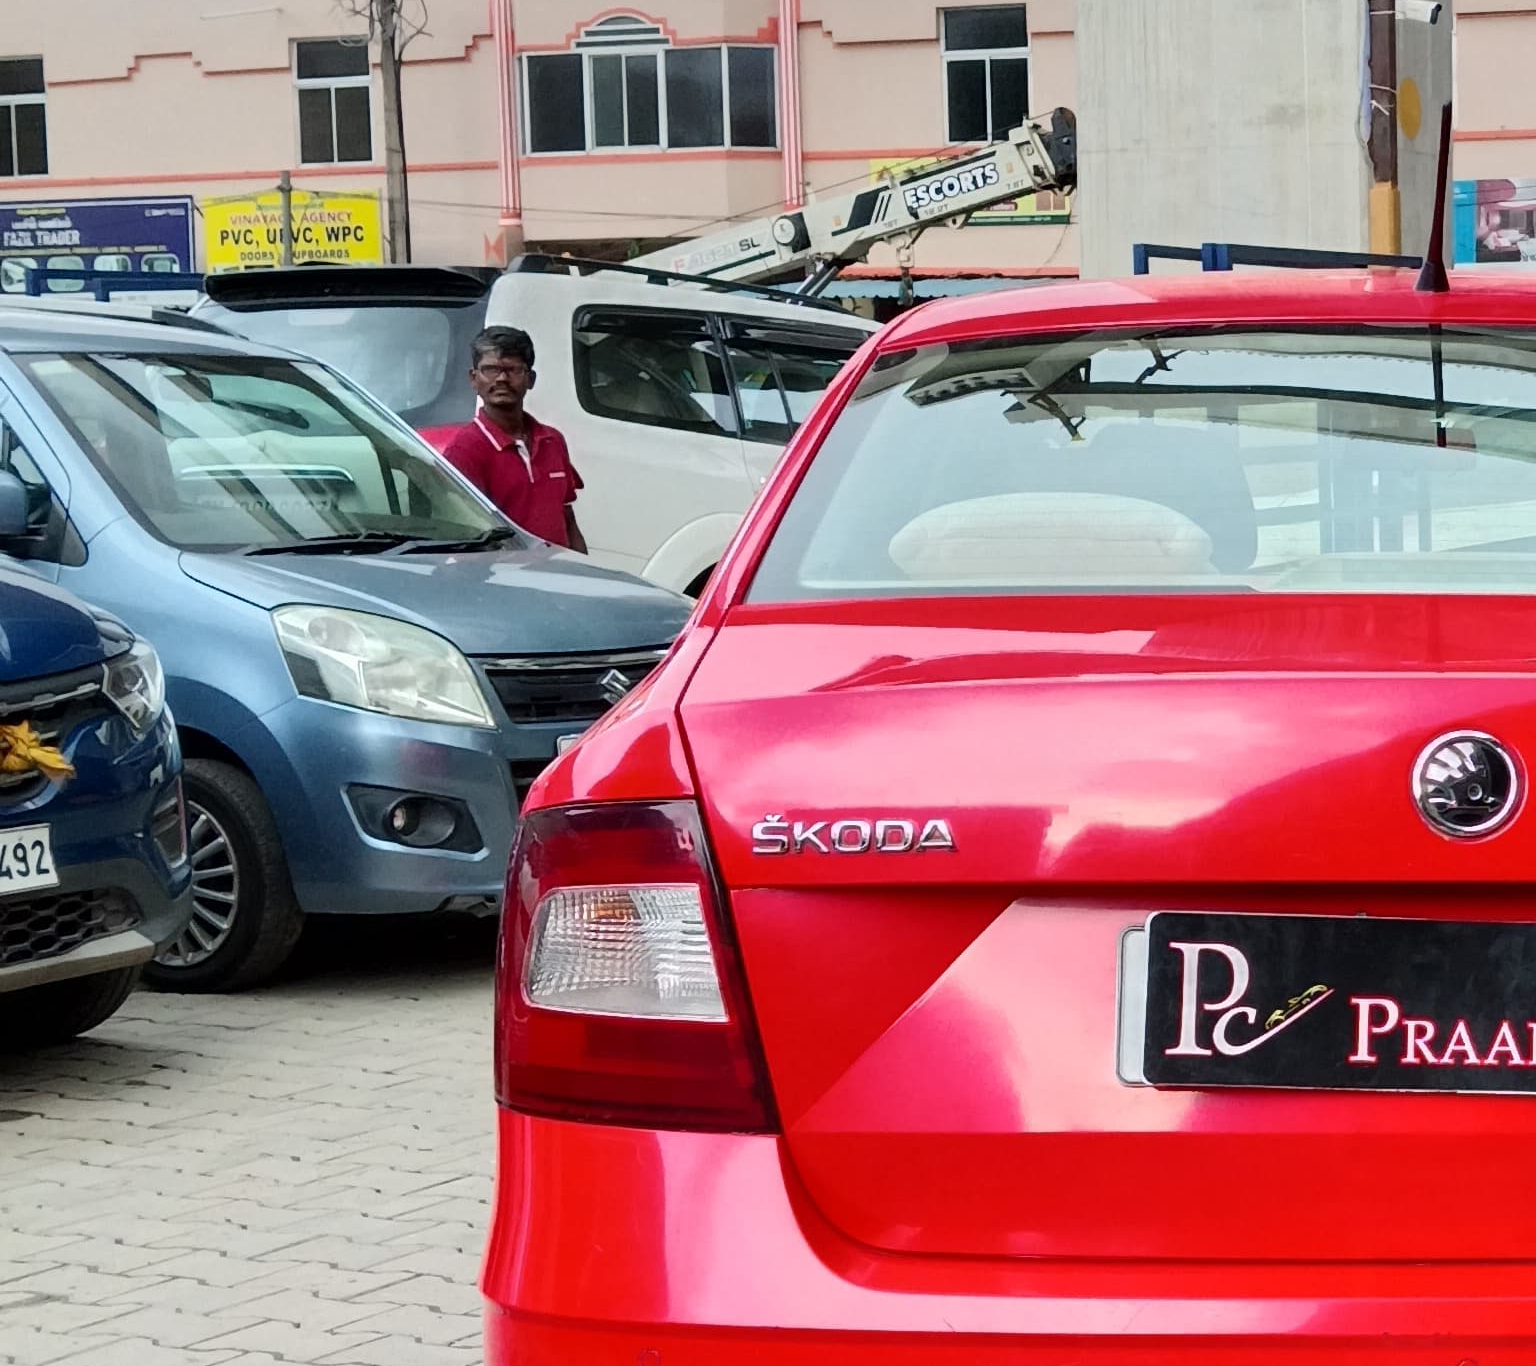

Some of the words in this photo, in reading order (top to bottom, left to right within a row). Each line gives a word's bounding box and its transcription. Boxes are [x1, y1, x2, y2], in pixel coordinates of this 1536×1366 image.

[902, 163, 999, 209] ESCORTS
[230, 212, 295, 226] VINAYA
[302, 210, 353, 223] AGENCY
[220, 228, 260, 249] PVC,
[325, 225, 364, 243] WPC
[293, 250, 350, 259] UPBOARDS
[751, 814, 958, 855] ŠKODA
